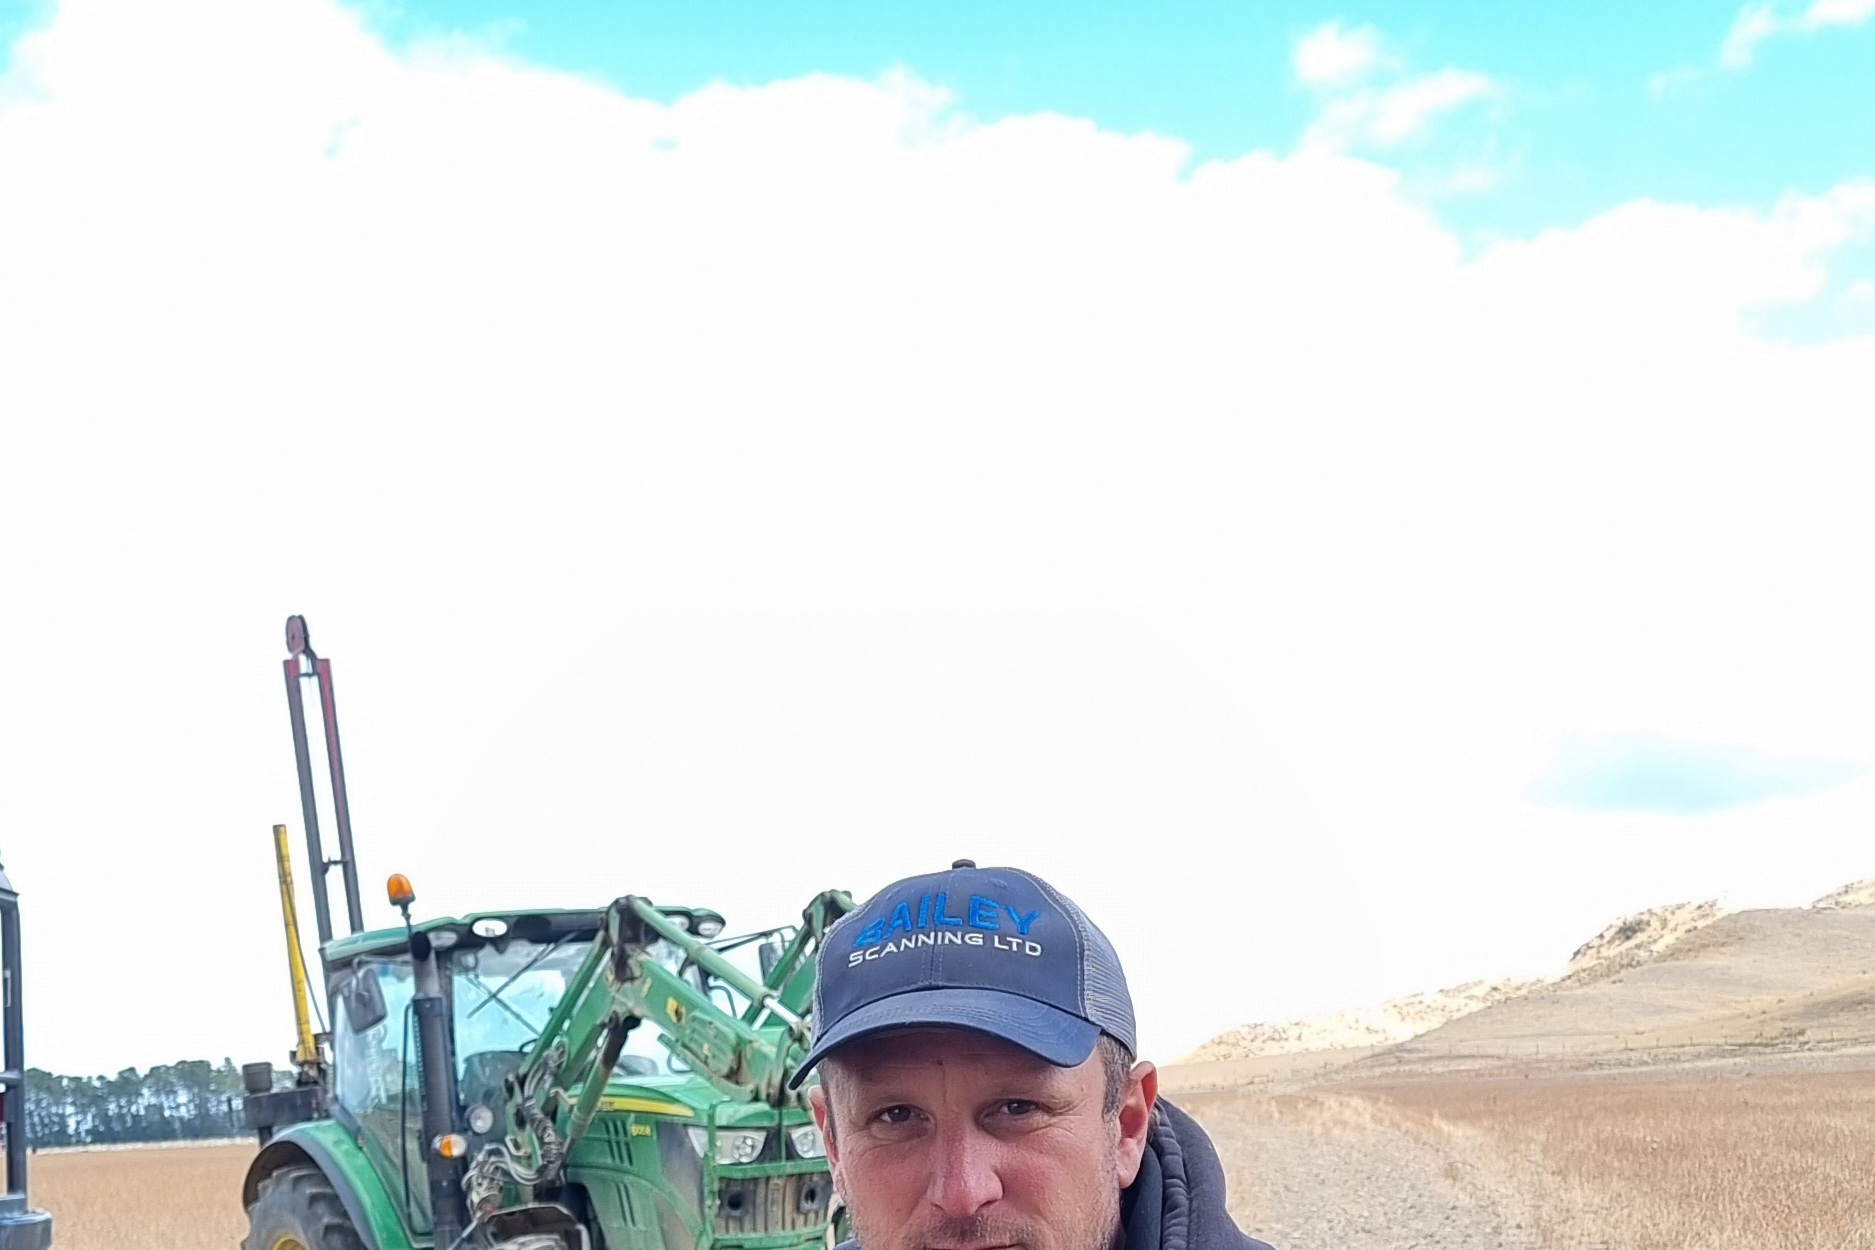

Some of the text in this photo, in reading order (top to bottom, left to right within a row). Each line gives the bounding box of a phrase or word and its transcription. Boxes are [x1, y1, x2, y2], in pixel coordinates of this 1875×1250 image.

[853, 892, 1040, 948] BAILEY
[848, 931, 1043, 968] SCANNING LTD
